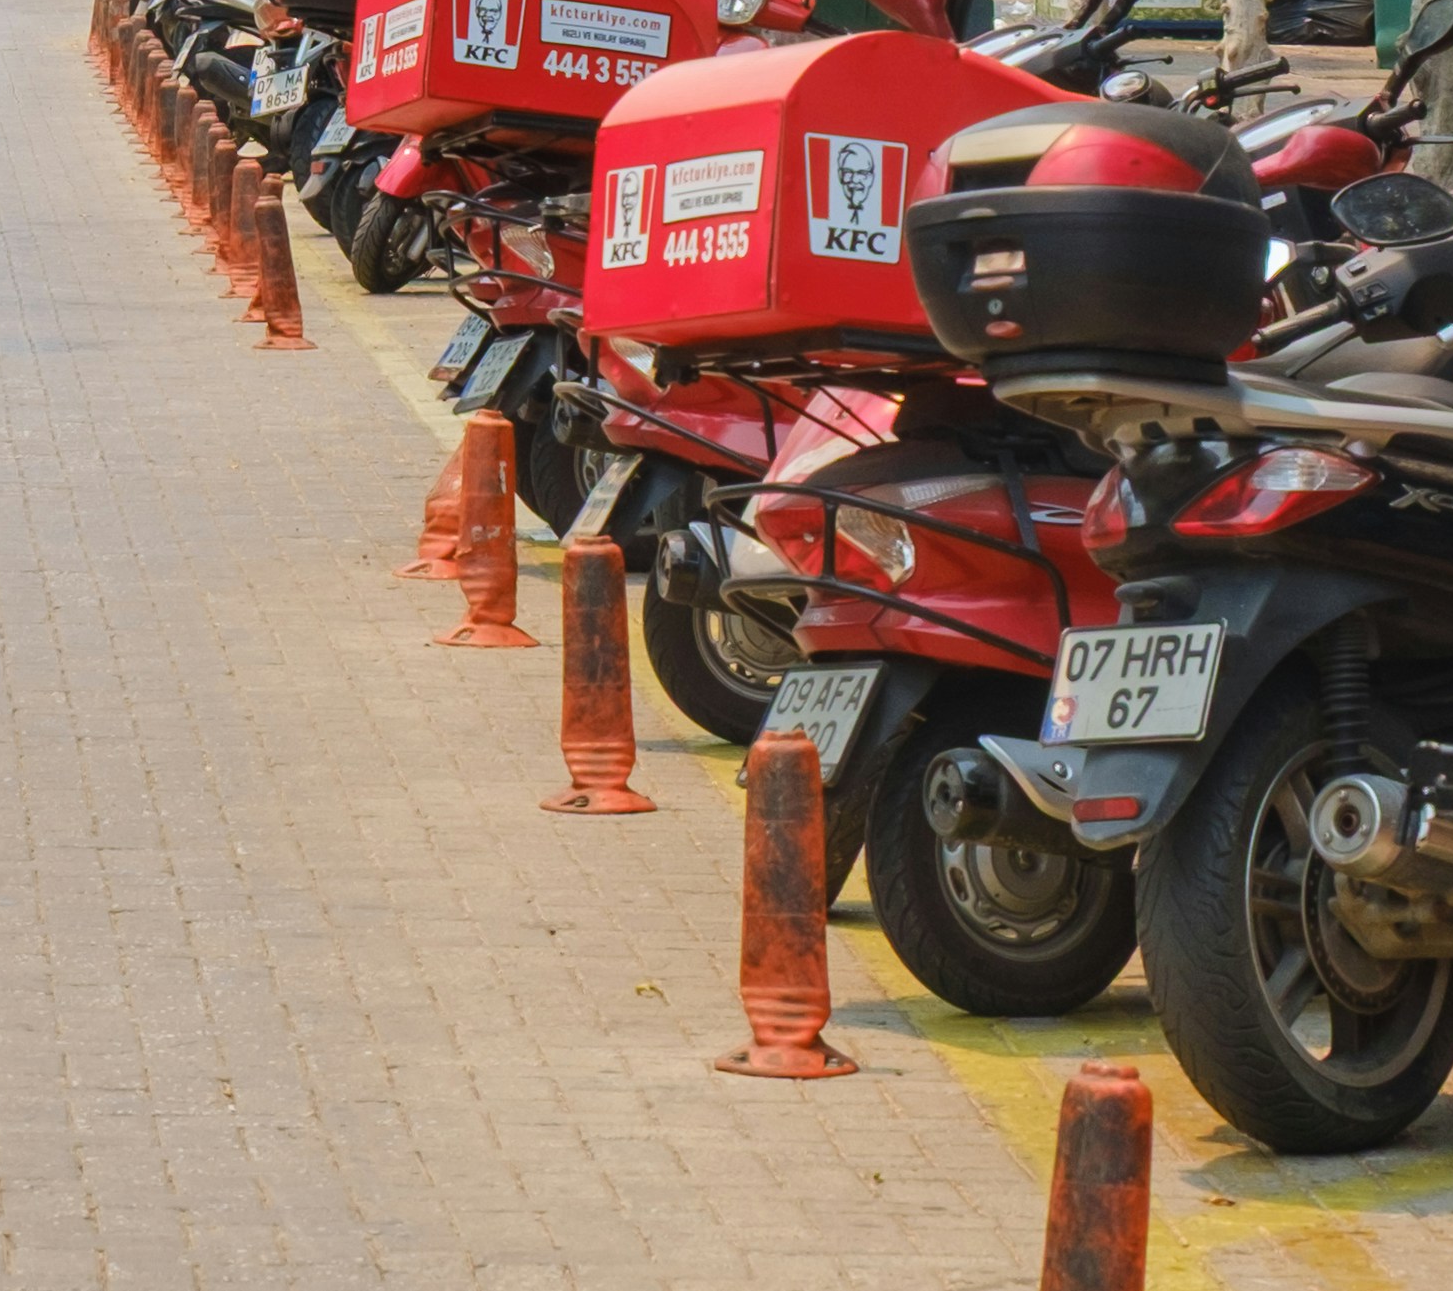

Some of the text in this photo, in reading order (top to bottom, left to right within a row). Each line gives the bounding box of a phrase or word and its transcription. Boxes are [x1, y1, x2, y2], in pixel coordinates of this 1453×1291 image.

[551, 4, 661, 30] kfcturkiye.com
[464, 44, 509, 65] KFC
[543, 50, 590, 80] 444
[595, 56, 610, 83] 3
[257, 70, 303, 95] 07 MA
[266, 87, 298, 108] 8635
[672, 161, 755, 186] kfcturkiye.com
[609, 240, 641, 264] KFC
[663, 221, 751, 267] 444 3 555
[825, 227, 886, 256] KFC
[1066, 632, 1213, 682] 07 HRH
[776, 675, 868, 715] 09 AFA
[1107, 685, 1159, 730] 67
